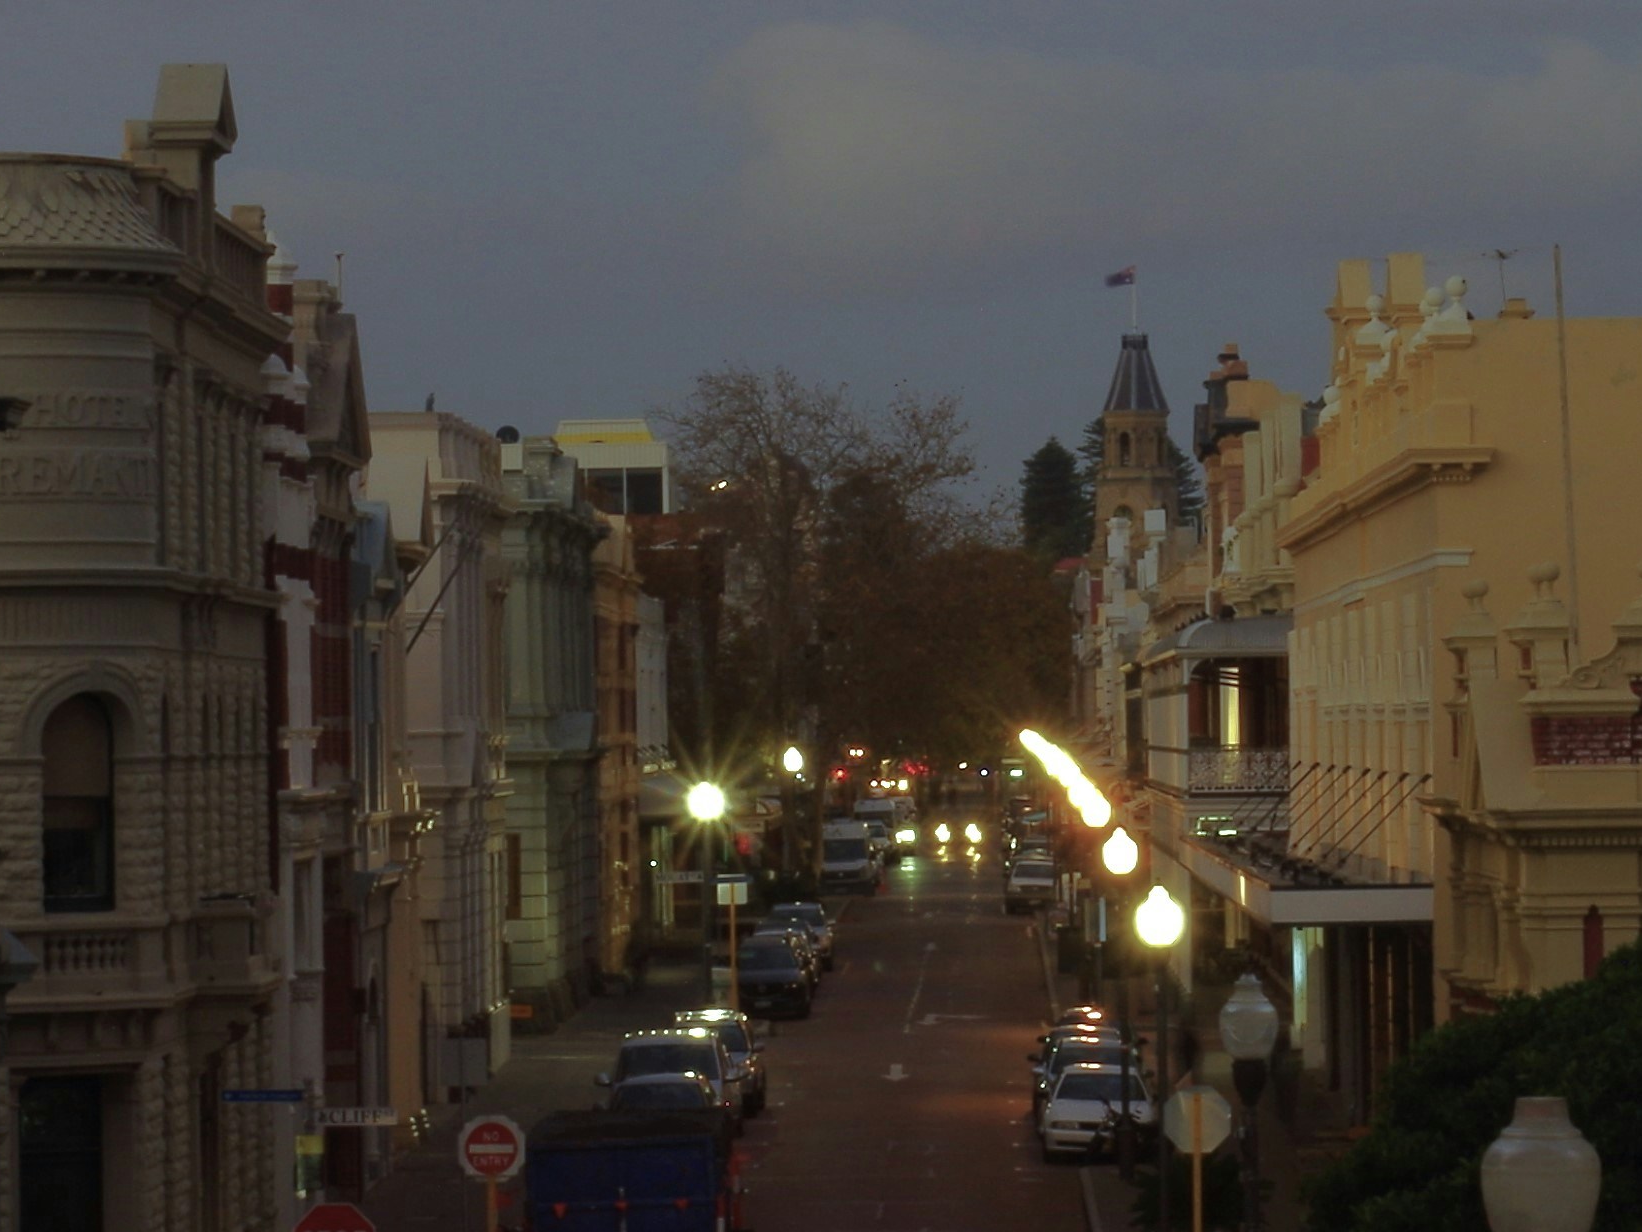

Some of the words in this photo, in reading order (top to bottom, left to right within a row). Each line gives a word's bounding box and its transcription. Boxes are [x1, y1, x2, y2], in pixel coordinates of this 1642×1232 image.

[329, 1109, 382, 1124] CLIFF
[482, 1130, 500, 1142] NO
[472, 1155, 510, 1167] ENTRY
